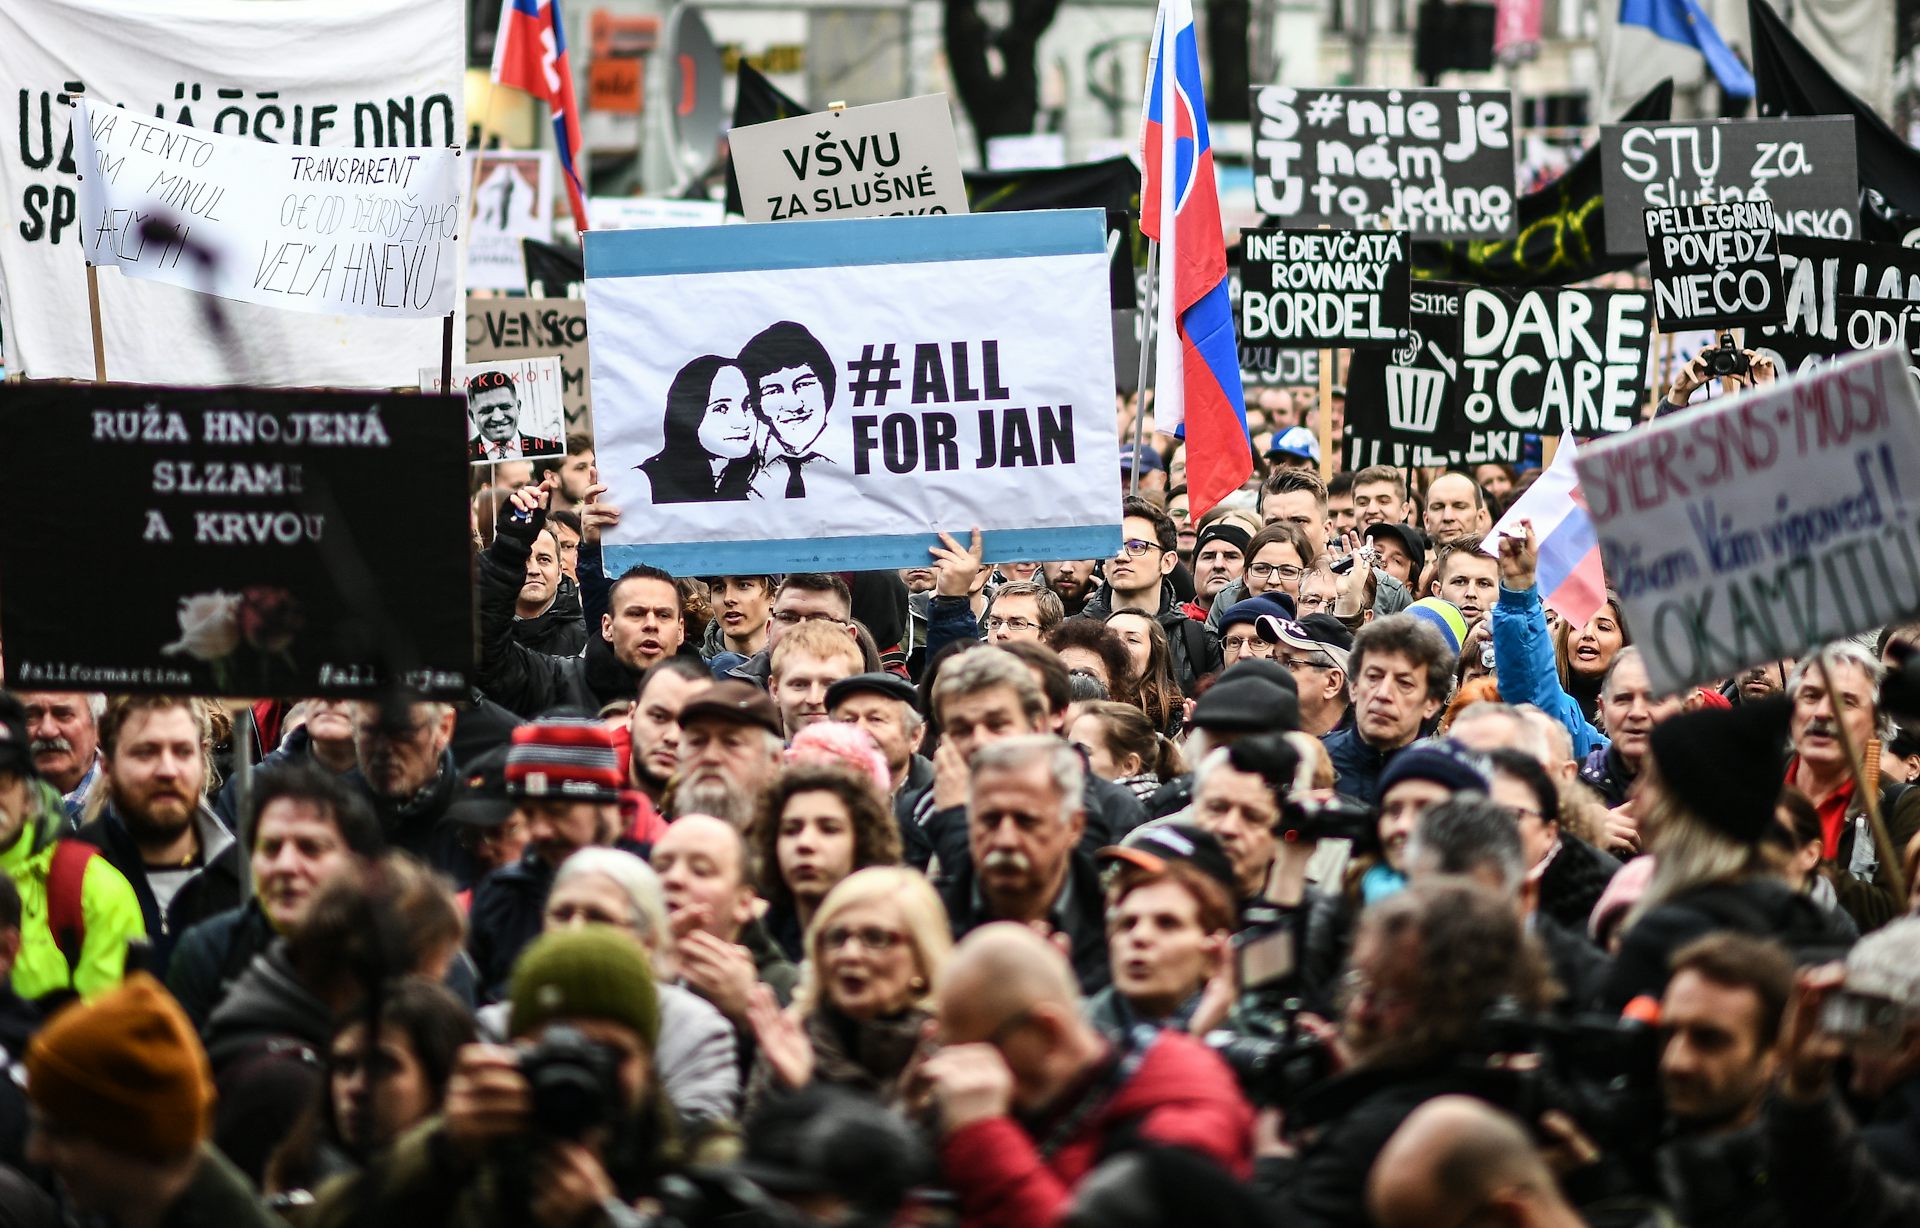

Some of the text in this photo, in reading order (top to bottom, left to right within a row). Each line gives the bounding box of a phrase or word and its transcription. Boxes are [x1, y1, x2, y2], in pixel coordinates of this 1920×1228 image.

[1304, 89, 1509, 162] #nie je
[130, 120, 214, 168] TENTO
[291, 156, 420, 189] TRANSPARENT
[782, 130, 901, 181] VŠVU
[1316, 135, 1442, 180] nám
[1621, 126, 1813, 182] STU za
[146, 170, 225, 222] MINUL
[767, 165, 936, 221] ZA SLUŠNÉ
[1310, 176, 1512, 217] to jedno
[1645, 201, 1775, 237] PELLEGRINI
[1246, 231, 1402, 261] INÉ DIEVČATÁ
[1662, 229, 1775, 268] POVEDZ
[253, 239, 337, 298] VEĽA
[340, 241, 441, 310] HNEVU
[1271, 259, 1389, 290] ROVNAKÝ
[1653, 264, 1771, 320] NIEČO
[1243, 291, 1408, 339] BORDEL.
[1463, 288, 1646, 363] DARE
[847, 339, 1010, 408] #ALL
[1463, 359, 1499, 424] TO
[1496, 354, 1638, 431] CARE
[92, 403, 391, 446] RUŽA HNOJENÁ
[851, 404, 1076, 475] FOR JAN
[152, 460, 303, 493] SLZAMI
[143, 509, 325, 544] A KRVOU
[318, 661, 465, 693] #allrjan
